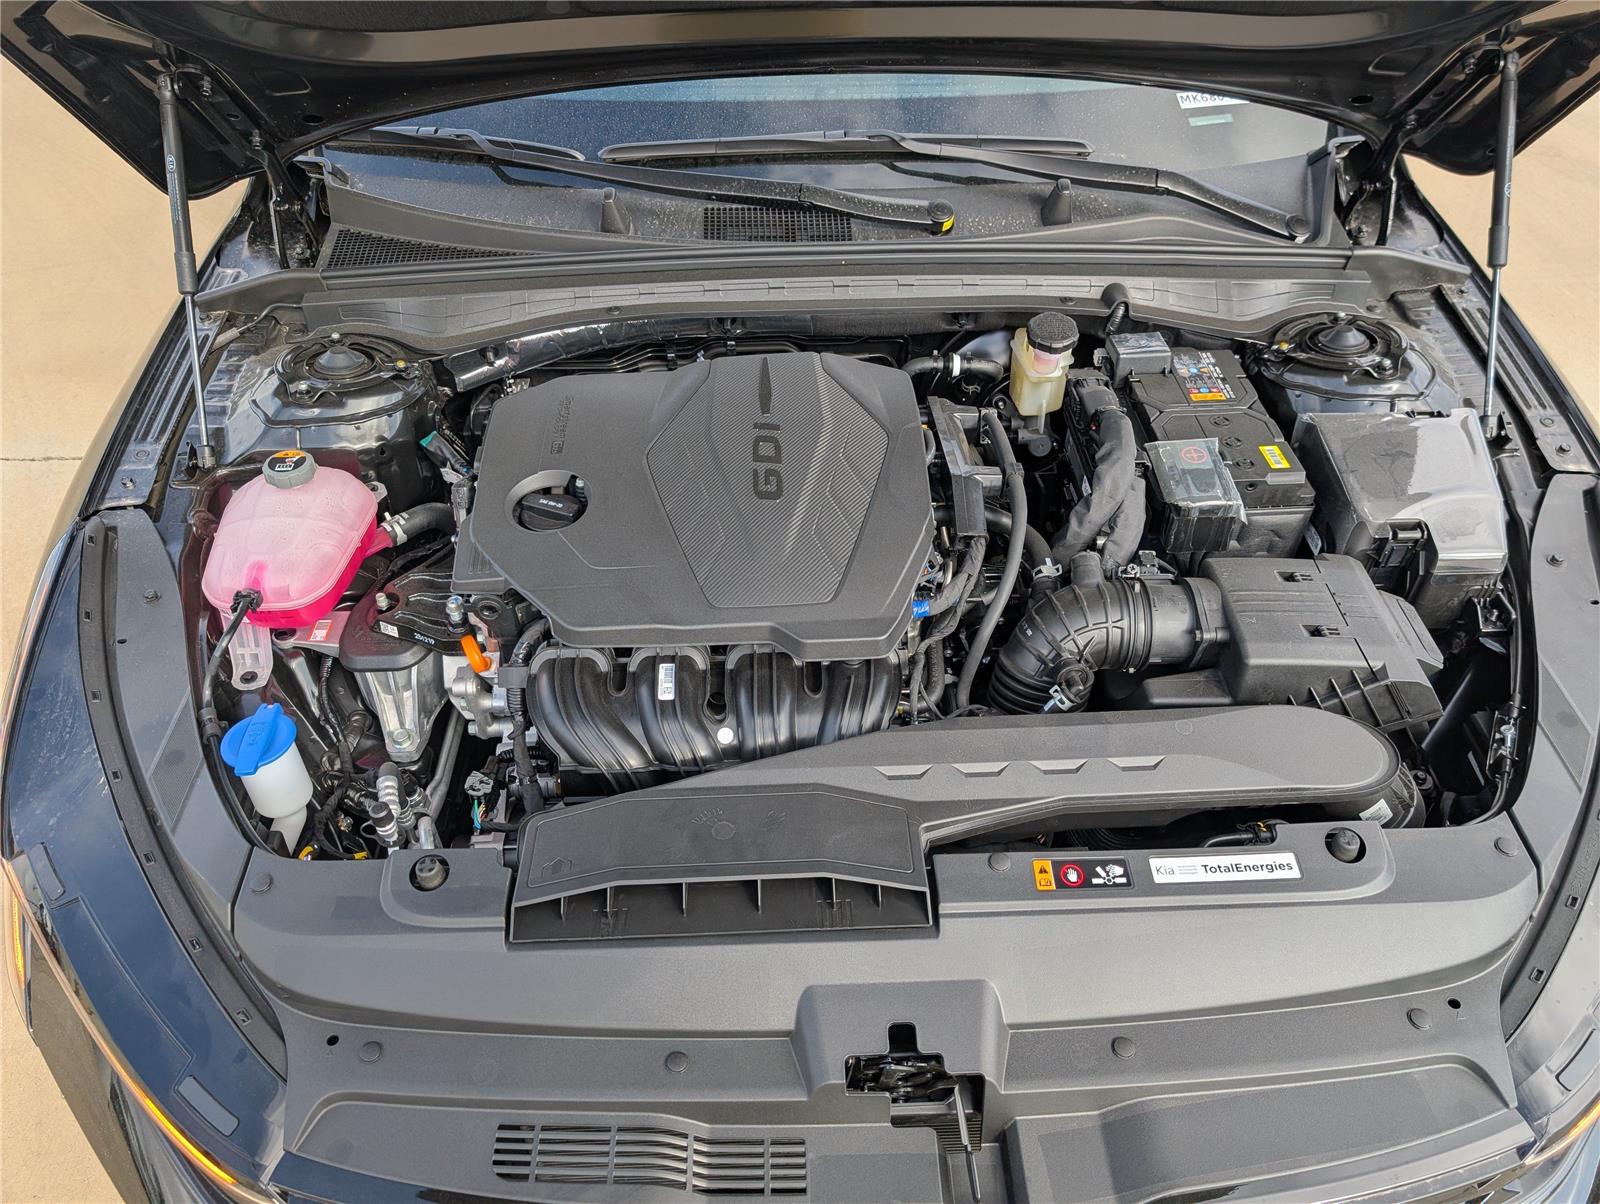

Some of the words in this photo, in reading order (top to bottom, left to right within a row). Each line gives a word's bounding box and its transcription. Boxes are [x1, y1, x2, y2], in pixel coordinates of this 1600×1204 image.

[753, 423, 782, 500] GDI
[1155, 865, 1175, 876] Kia
[1201, 861, 1293, 874] TotalEnergies
